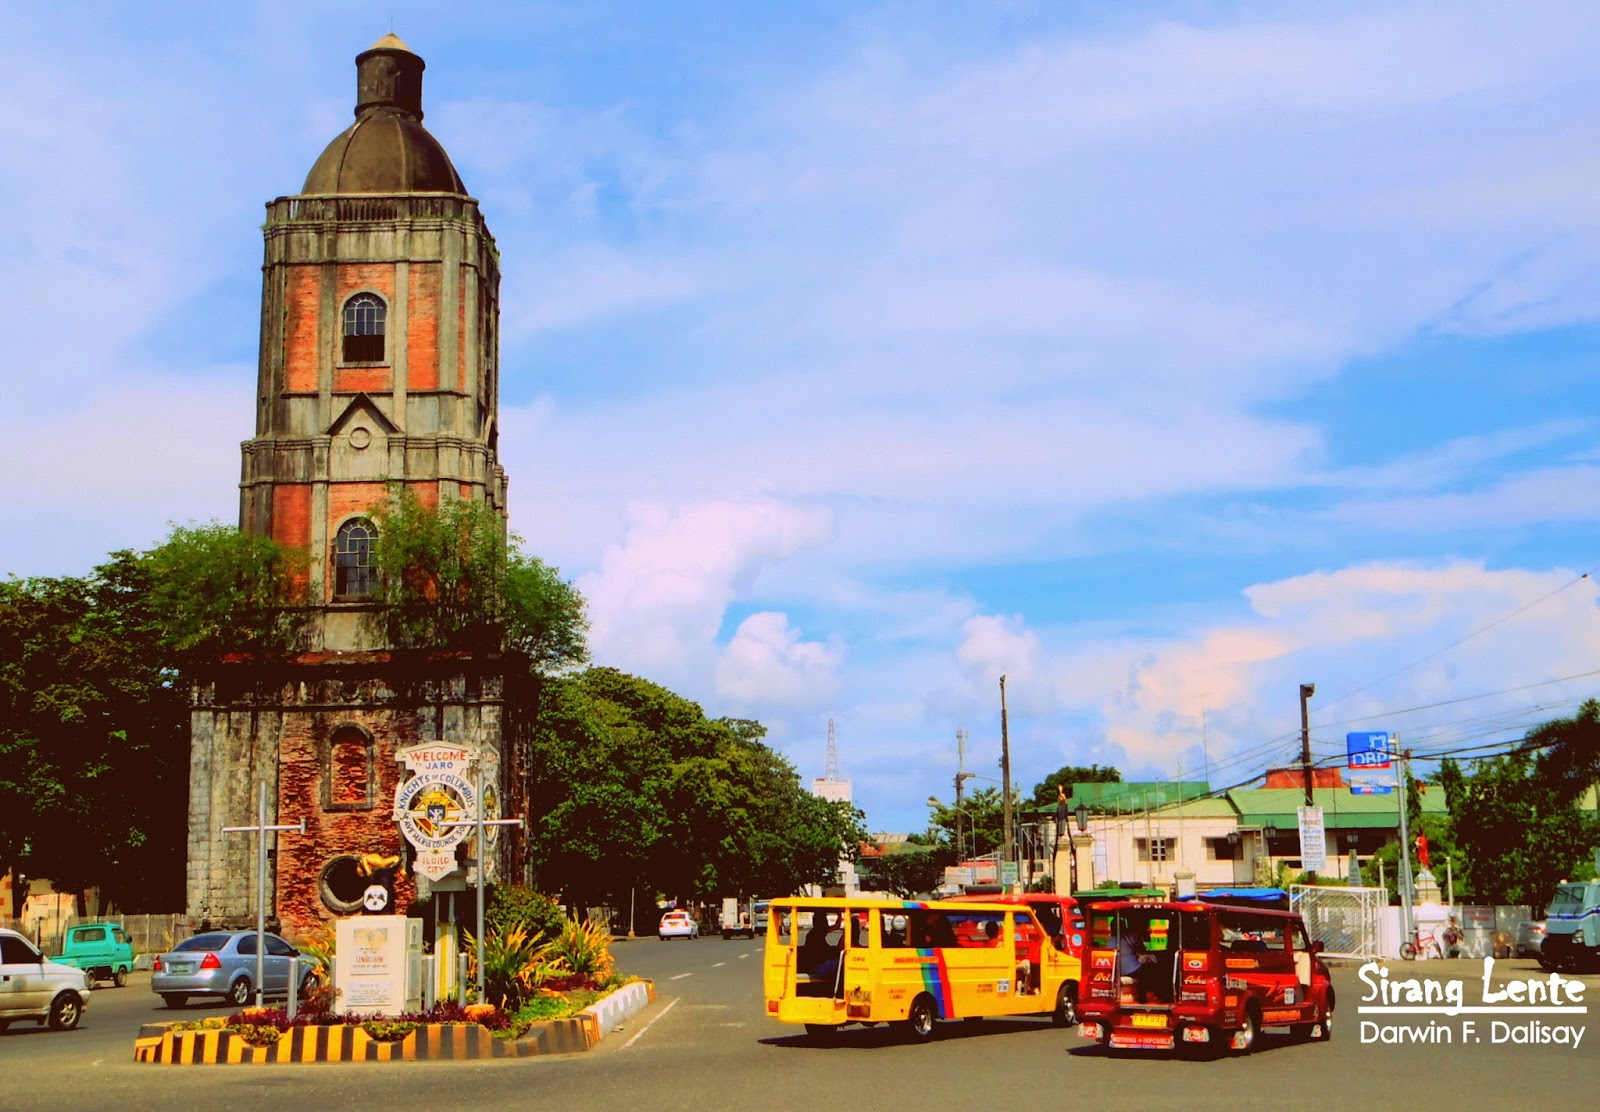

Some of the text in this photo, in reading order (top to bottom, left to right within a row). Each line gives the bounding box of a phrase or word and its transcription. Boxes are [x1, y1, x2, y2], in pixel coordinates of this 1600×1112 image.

[410, 751, 469, 761] WELCOME
[1352, 752, 1388, 767] DBP
[398, 774, 430, 810] KNIGHTS
[439, 773, 476, 808] COLUMBUS
[404, 820, 415, 834] AVE
[412, 833, 432, 848] MARIA
[432, 835, 457, 848] COUNCIL
